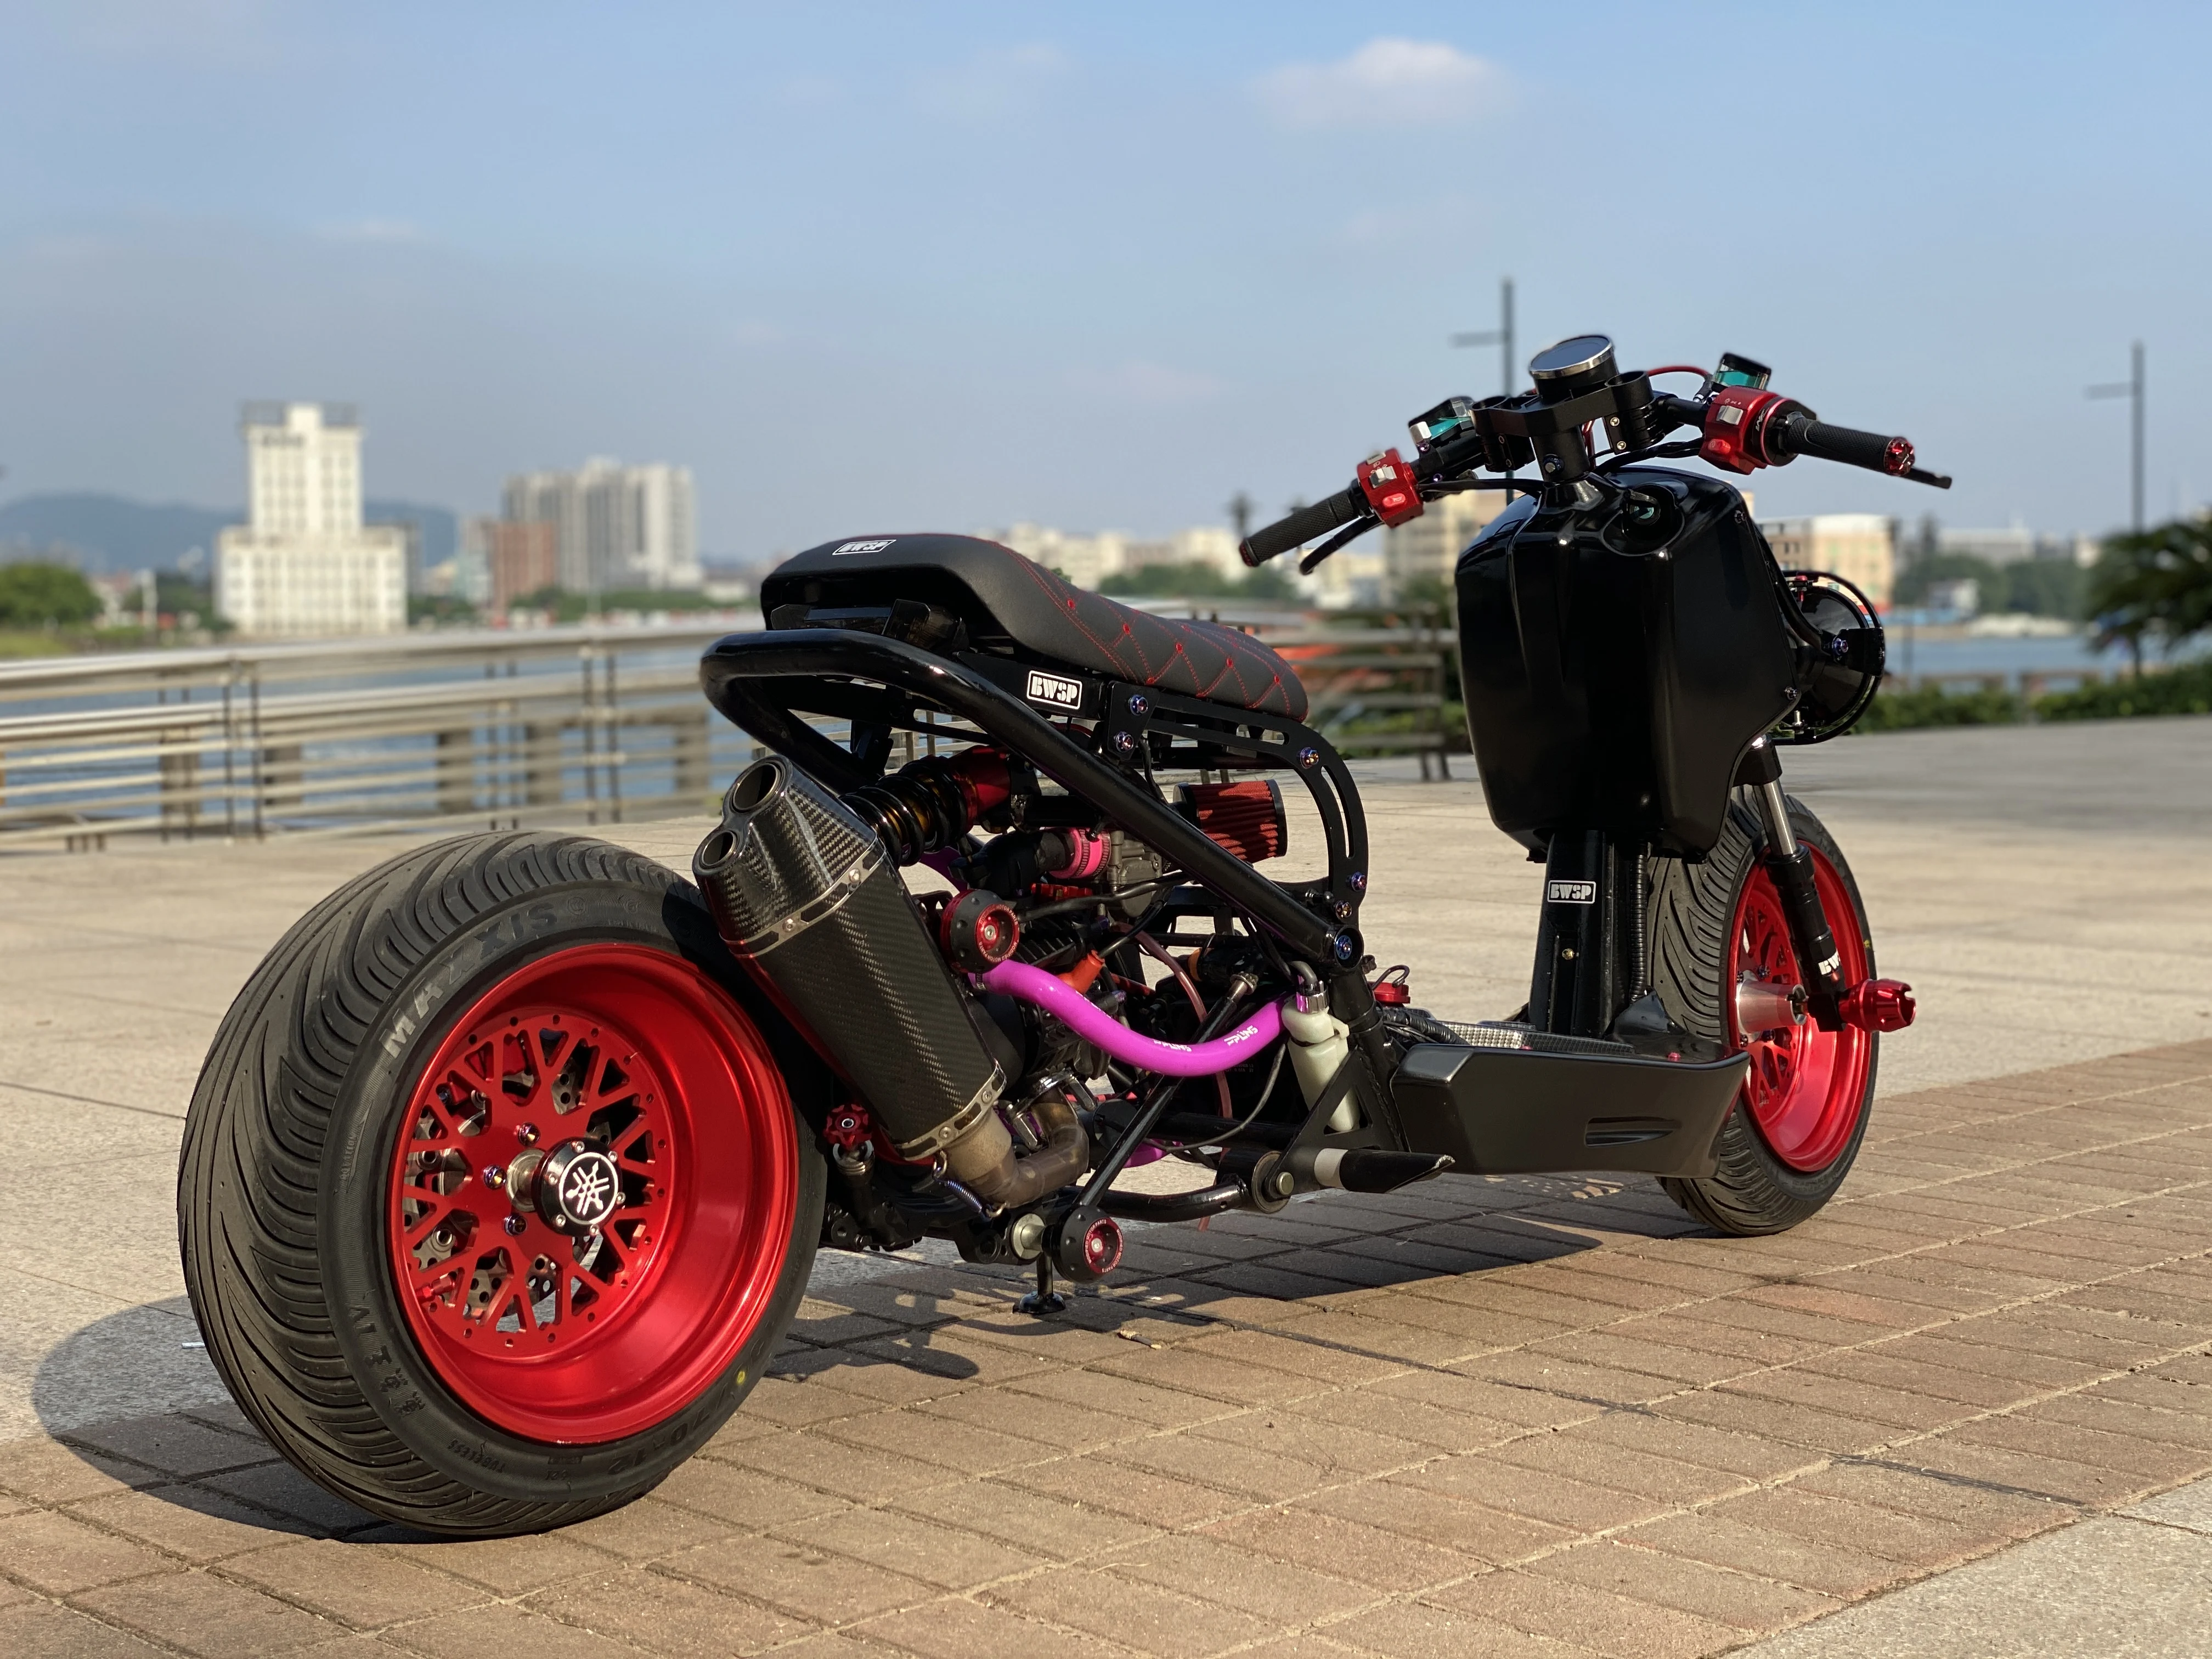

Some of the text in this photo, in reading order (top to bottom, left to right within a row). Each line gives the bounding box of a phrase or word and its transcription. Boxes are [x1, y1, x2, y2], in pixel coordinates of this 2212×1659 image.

[1031, 676, 1077, 702] BWSP
[1550, 884, 1592, 899] BWSP
[379, 901, 558, 1059] MAXXIS
